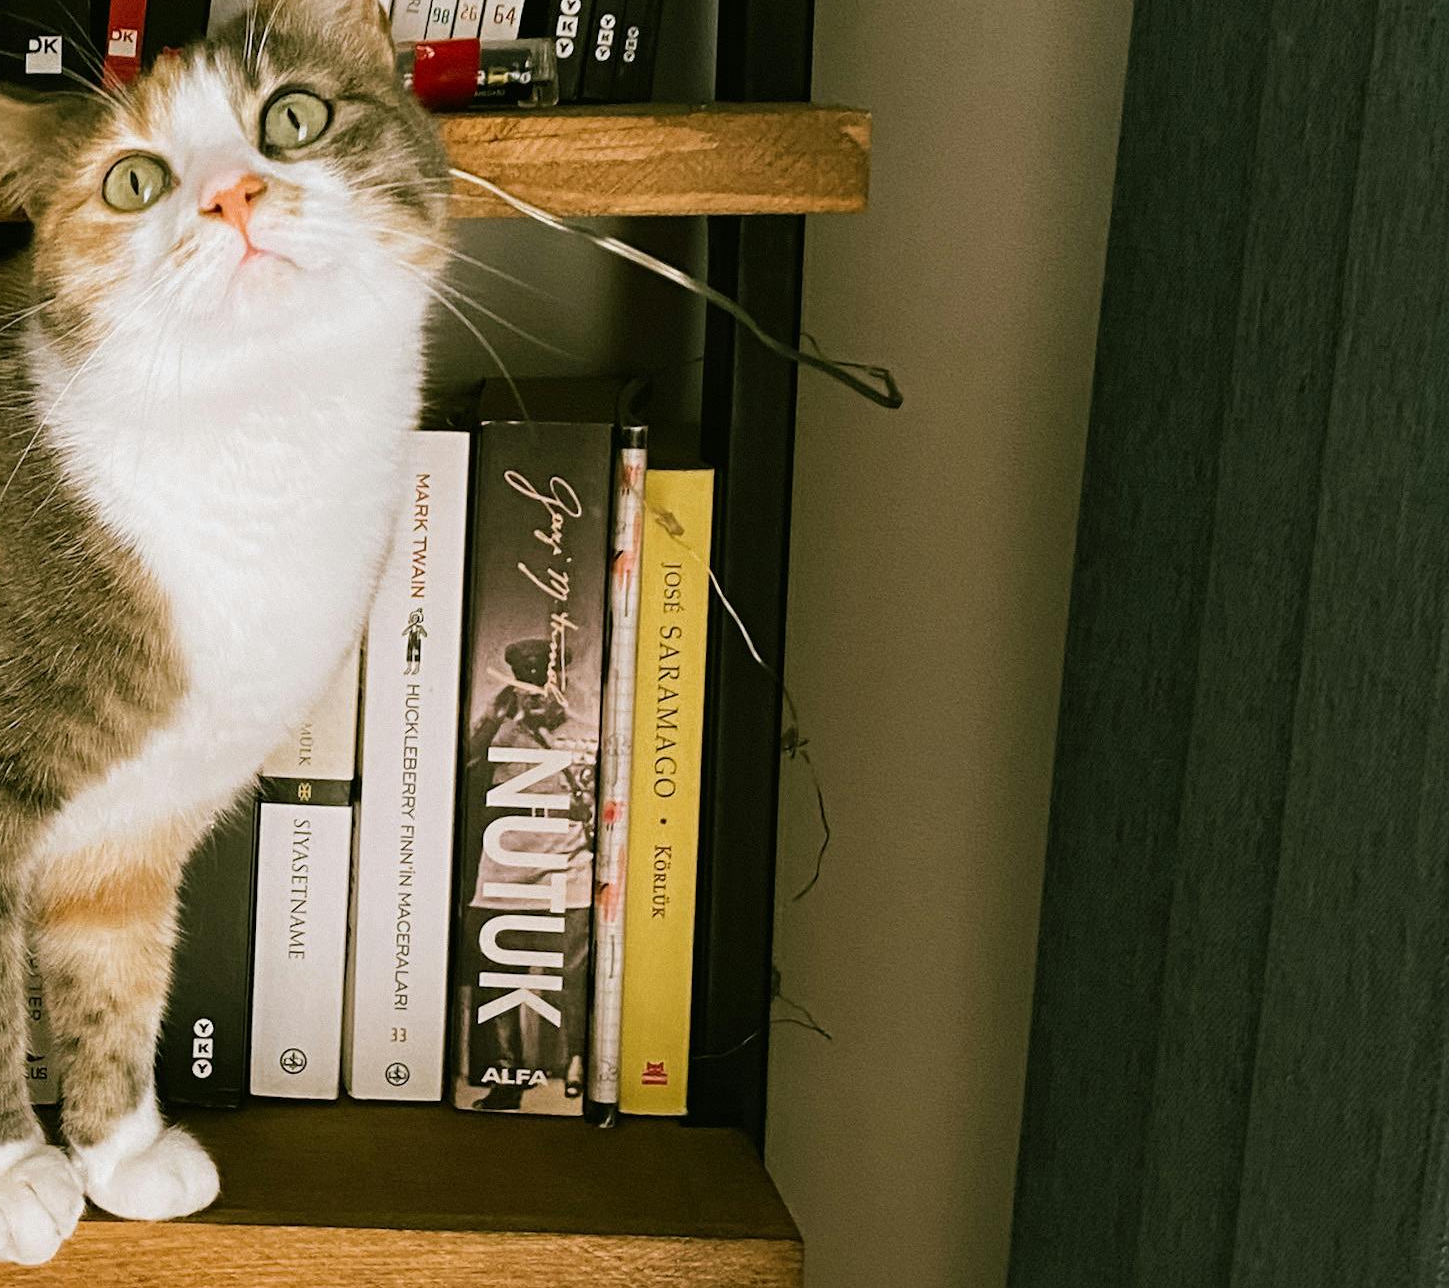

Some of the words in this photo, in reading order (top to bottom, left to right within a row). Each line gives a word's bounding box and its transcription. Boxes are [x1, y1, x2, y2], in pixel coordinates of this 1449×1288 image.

[493, 4, 517, 25] 64
[414, 473, 430, 531] MARK
[411, 536, 428, 598] TWAIN
[401, 684, 419, 817] HUCKLEBERRY
[288, 819, 311, 960] SİYASETNAME
[478, 746, 575, 1028] NUTUK
[394, 893, 412, 1011] MACERALARI
[391, 1028, 407, 1042] 33
[481, 1067, 548, 1086] ALFA
